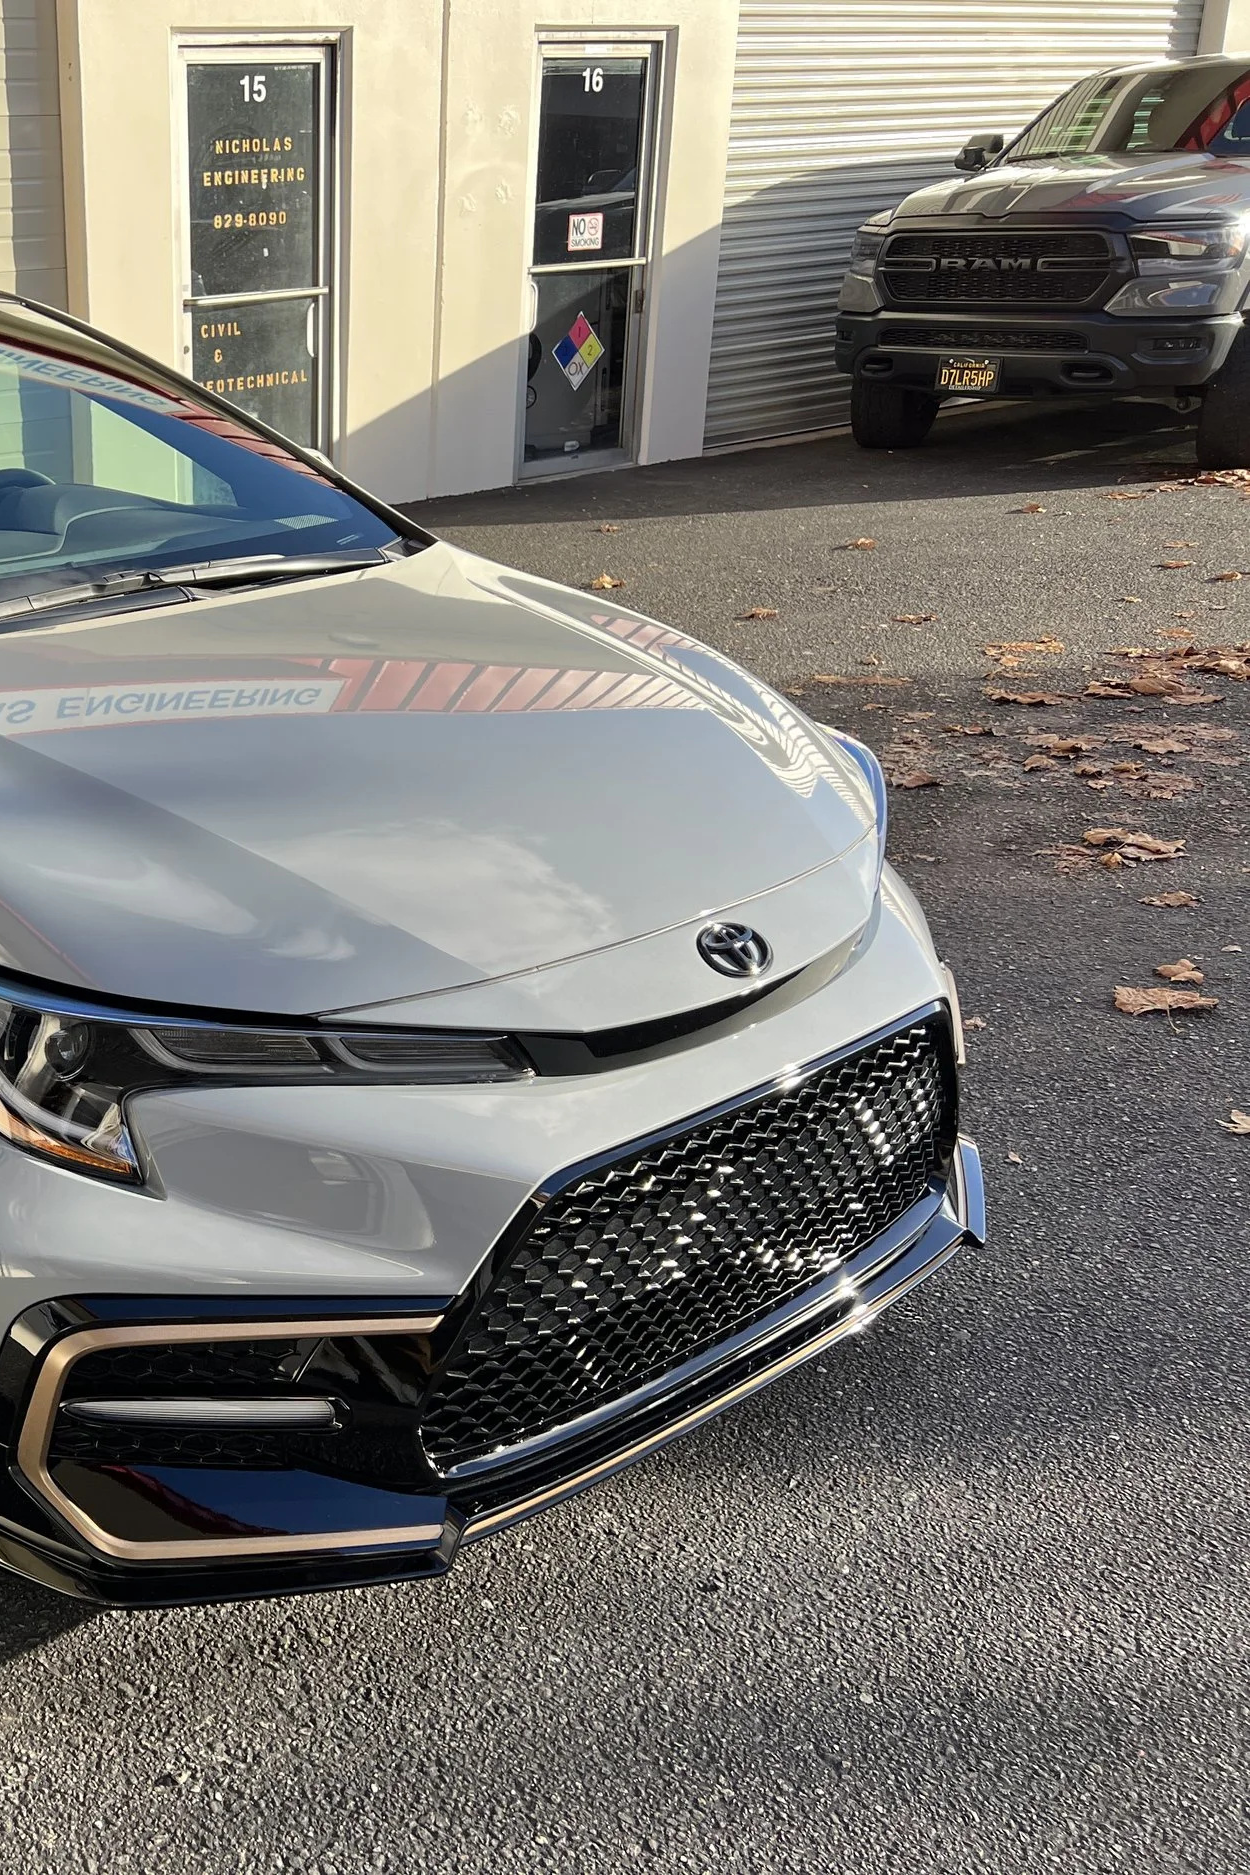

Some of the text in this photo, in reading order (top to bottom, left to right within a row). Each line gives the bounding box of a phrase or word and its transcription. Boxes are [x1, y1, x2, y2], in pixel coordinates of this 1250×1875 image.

[240, 75, 267, 102] 15
[582, 68, 604, 92] 16
[215, 137, 293, 154] NICHOLAS
[203, 167, 305, 186] ENGINEERING
[214, 211, 287, 229] 829-8090
[572, 218, 586, 236] NO
[571, 237, 600, 248] SMOKING
[941, 257, 1031, 270] RAM
[201, 322, 241, 339] CIVIL
[214, 349, 223, 363] &
[587, 344, 593, 356] 2
[568, 361, 584, 376] OX
[940, 369, 994, 387] D7LR5HP
